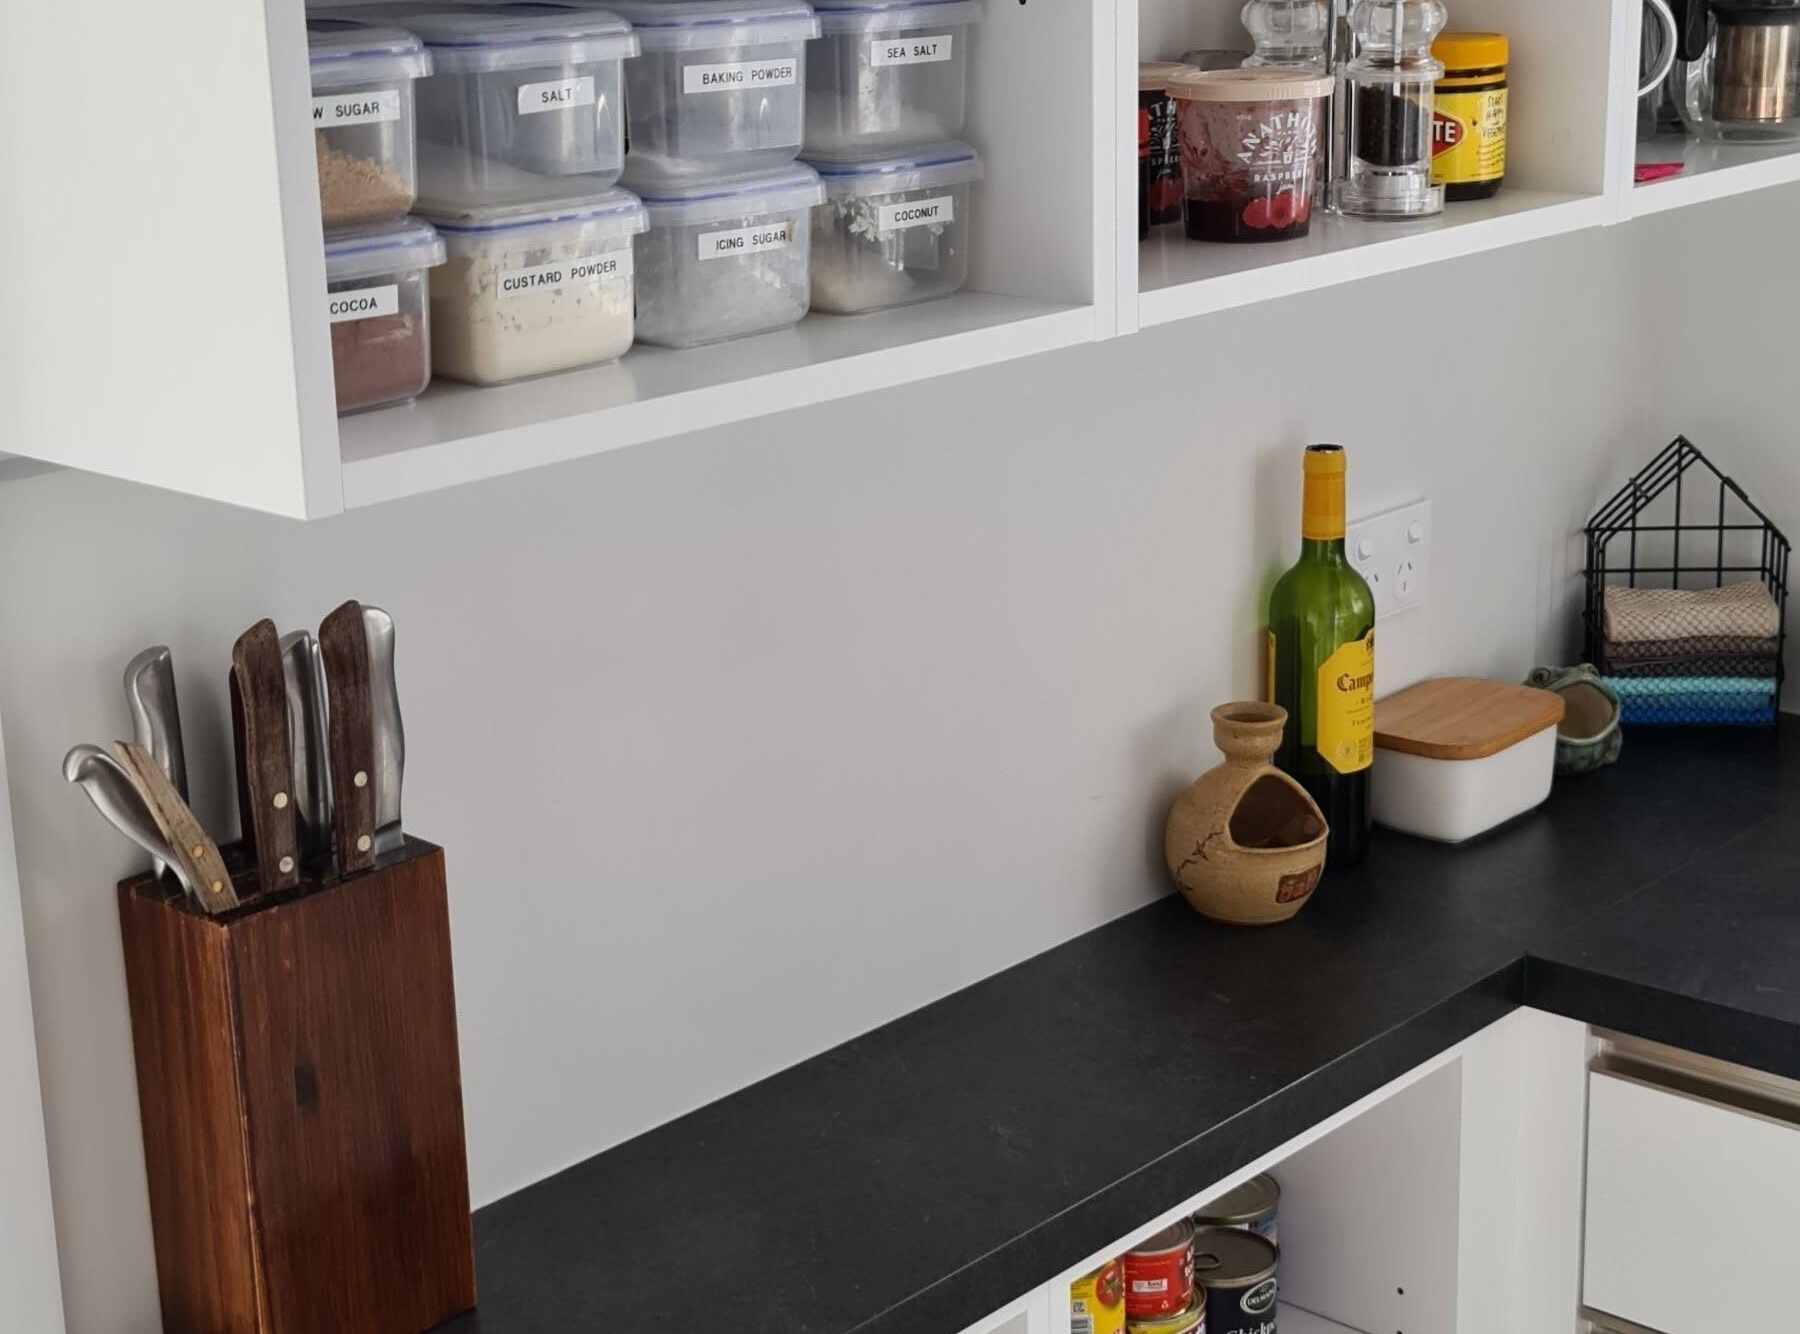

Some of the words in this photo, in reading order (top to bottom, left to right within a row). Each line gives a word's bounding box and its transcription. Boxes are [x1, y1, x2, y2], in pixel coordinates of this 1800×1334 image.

[887, 46, 906, 58] SEA
[914, 44, 938, 56] SALT
[702, 71, 743, 86] BAKING
[751, 66, 793, 81] POWDER
[541, 88, 572, 104] SALT
[335, 101, 381, 118] SUGAR
[894, 205, 939, 223] COCONUT
[715, 236, 744, 252] ICING
[752, 230, 786, 247] SUGAR
[503, 270, 563, 292] CUSTARD
[570, 259, 618, 279] POWDER
[329, 296, 379, 315] COCOA
